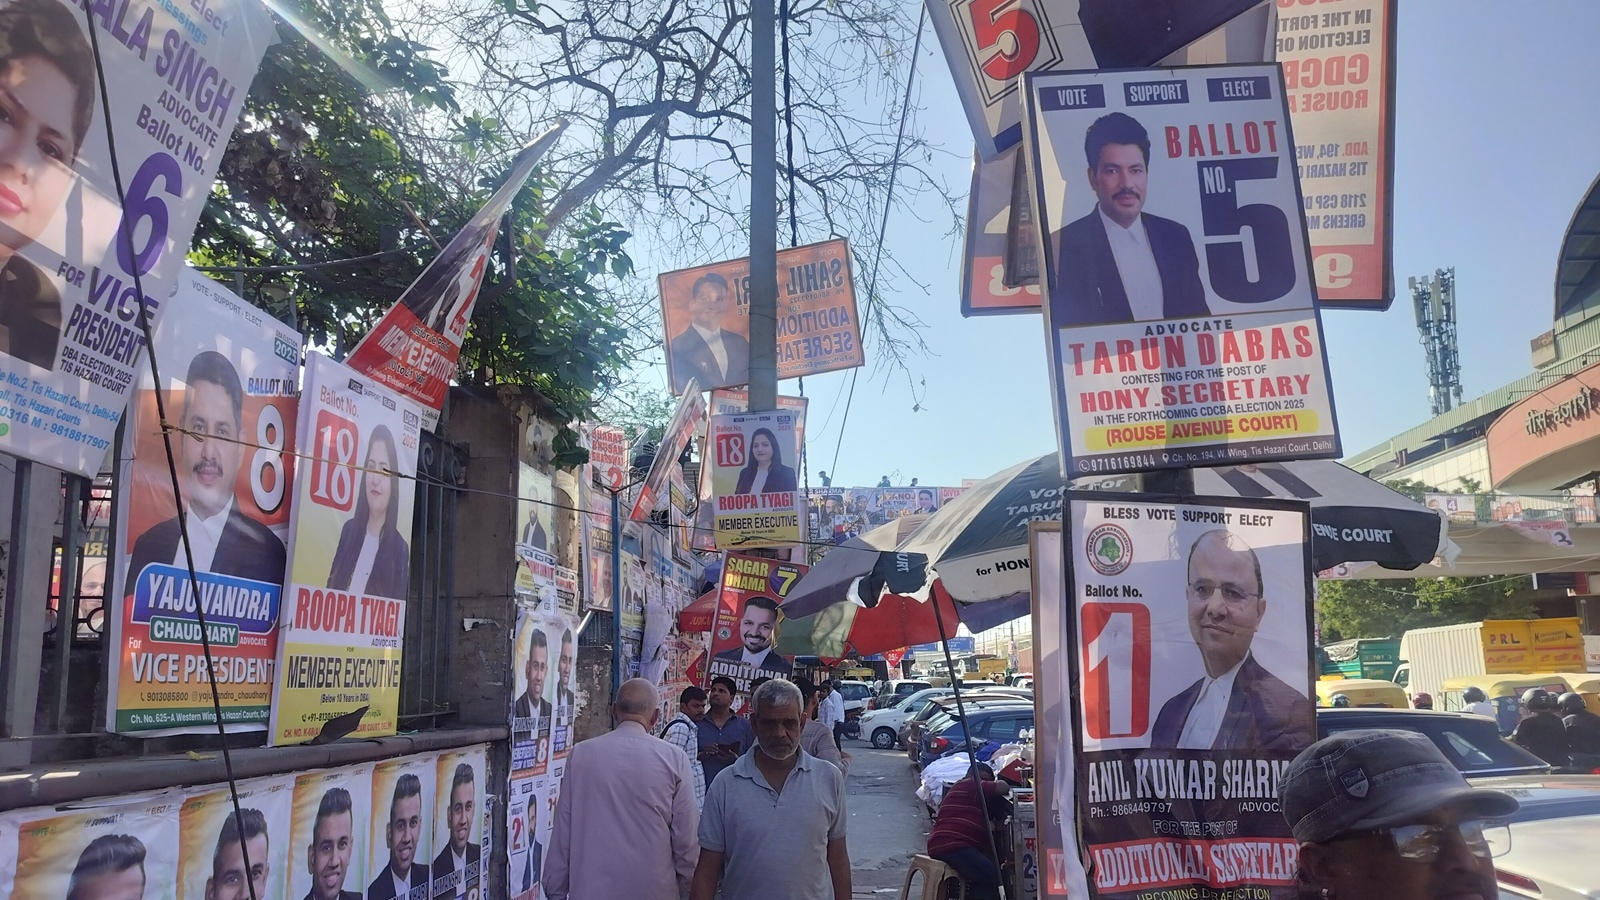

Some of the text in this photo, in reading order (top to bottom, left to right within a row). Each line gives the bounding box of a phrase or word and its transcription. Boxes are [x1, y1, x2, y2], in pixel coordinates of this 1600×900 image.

[190, 0, 229, 37] Elect
[969, 0, 1040, 80] 5
[156, 28, 237, 128] SINGH
[1222, 80, 1255, 98] ELECT
[1057, 89, 1087, 106] VOTE
[1129, 83, 1182, 102] SUPPORT
[157, 89, 219, 149] ADVOCATE
[136, 104, 205, 175] Ballot No.
[1165, 121, 1278, 158] BALLOT
[1203, 166, 1231, 194] NO.
[117, 152, 182, 277] 6
[1197, 157, 1296, 304] 5
[57, 261, 160, 330] FOR VICE
[192, 280, 262, 327] VOTE SUPPORT ELECT
[64, 303, 146, 368] PRESIDENT
[1145, 319, 1233, 336] ADVOCATE
[62, 345, 132, 384] DBA ELECTION 2025
[275, 340, 298, 364] 2025
[1069, 325, 1313, 376] TARUN DABAS
[60, 358, 126, 395] TIS HAZARI COURT
[247, 378, 295, 395] BALLOT NO.
[1121, 364, 1267, 385] CONTESTING FOR THE POST OF
[7, 371, 120, 423] No.2, Tis Hazari Court, Delhi-54
[320, 385, 359, 418] Ballot No.
[1162, 374, 1311, 406] SECRETARY
[14, 393, 81, 426] Tis Hazari Courts
[404, 413, 418, 427] DBA
[1094, 399, 1305, 425] IN THE FORTHCOMING CDCBA ELECTION 2025
[50, 423, 110, 451] 9818817907
[402, 432, 417, 450] 2025
[716, 425, 733, 433] Ballot
[1106, 415, 1298, 447] (ROUSE AVENUE COURT)
[250, 404, 286, 515] 8
[718, 436, 744, 465] 18
[1091, 454, 1155, 472] 9716169844
[1172, 452, 1186, 463] Ch.
[1187, 451, 1199, 462] No.
[1251, 445, 1262, 456] Tis
[1263, 443, 1287, 455] Hazari
[1289, 442, 1311, 454] Court,
[1313, 440, 1332, 451] Delhi
[314, 425, 354, 505] 18
[719, 492, 794, 511] ROOPA TYAGI
[719, 517, 752, 531] MEMBER
[755, 515, 798, 528] EXECUTIVE
[1103, 507, 1273, 527] BLESS VOTE SUPPORT ELECT
[1342, 528, 1393, 543] COURT
[1554, 531, 1572, 546] 3
[727, 557, 769, 577] SAGAR
[976, 567, 992, 577] for
[725, 573, 766, 592] DHAMA
[778, 571, 797, 596] 7
[1085, 585, 1142, 598] Ballot No.
[148, 573, 271, 621] YAJUVANDRA
[295, 588, 400, 637] ROOPA TYAGI
[129, 637, 142, 649] For
[154, 620, 267, 646] CHAUDHARY ADVOCATE
[371, 638, 397, 648] ADVOCATE
[131, 652, 275, 684] VICE PRESIDENT
[287, 655, 399, 689] MEMBER EXECUTIVE
[1088, 612, 1133, 735] 1
[147, 691, 189, 701] 9013085800
[321, 693, 336, 704] (Below
[344, 694, 354, 703] Years
[131, 709, 260, 724] Ch. No. 625-A Western Hazari Courts,
[538, 739, 547, 763] 8
[1088, 759, 1287, 803] ANIL KUMAR SHARM
[1091, 802, 1172, 818] Ph.: 9868449797
[1153, 820, 1238, 836] FOR THE POST OF
[465, 860, 479, 881] KHARI
[1096, 841, 1210, 888] ADDITIONAL
